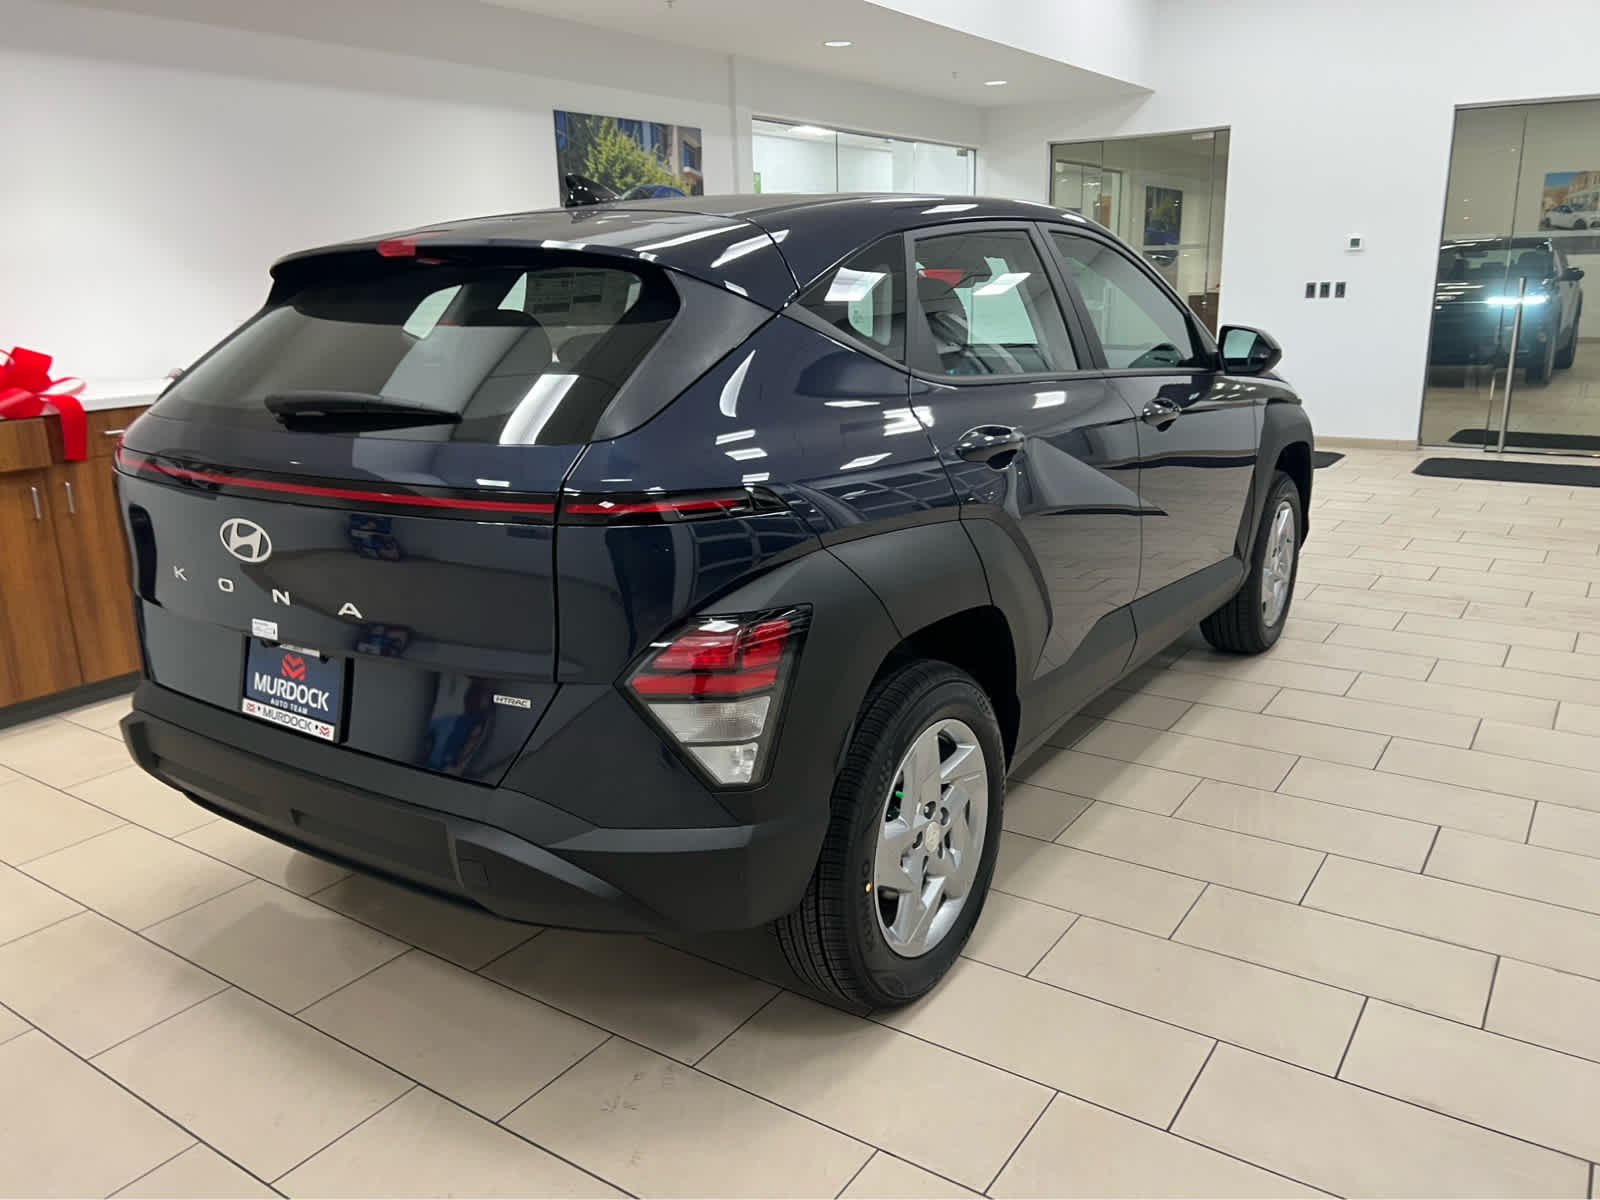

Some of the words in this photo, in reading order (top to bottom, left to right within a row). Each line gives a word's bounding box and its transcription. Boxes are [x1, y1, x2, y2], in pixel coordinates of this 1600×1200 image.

[173, 564, 363, 620] KONA
[254, 672, 329, 711] MURDOCK
[270, 698, 289, 708] AUTO
[290, 704, 308, 714] TEAM
[263, 706, 312, 731] MURDOCK
